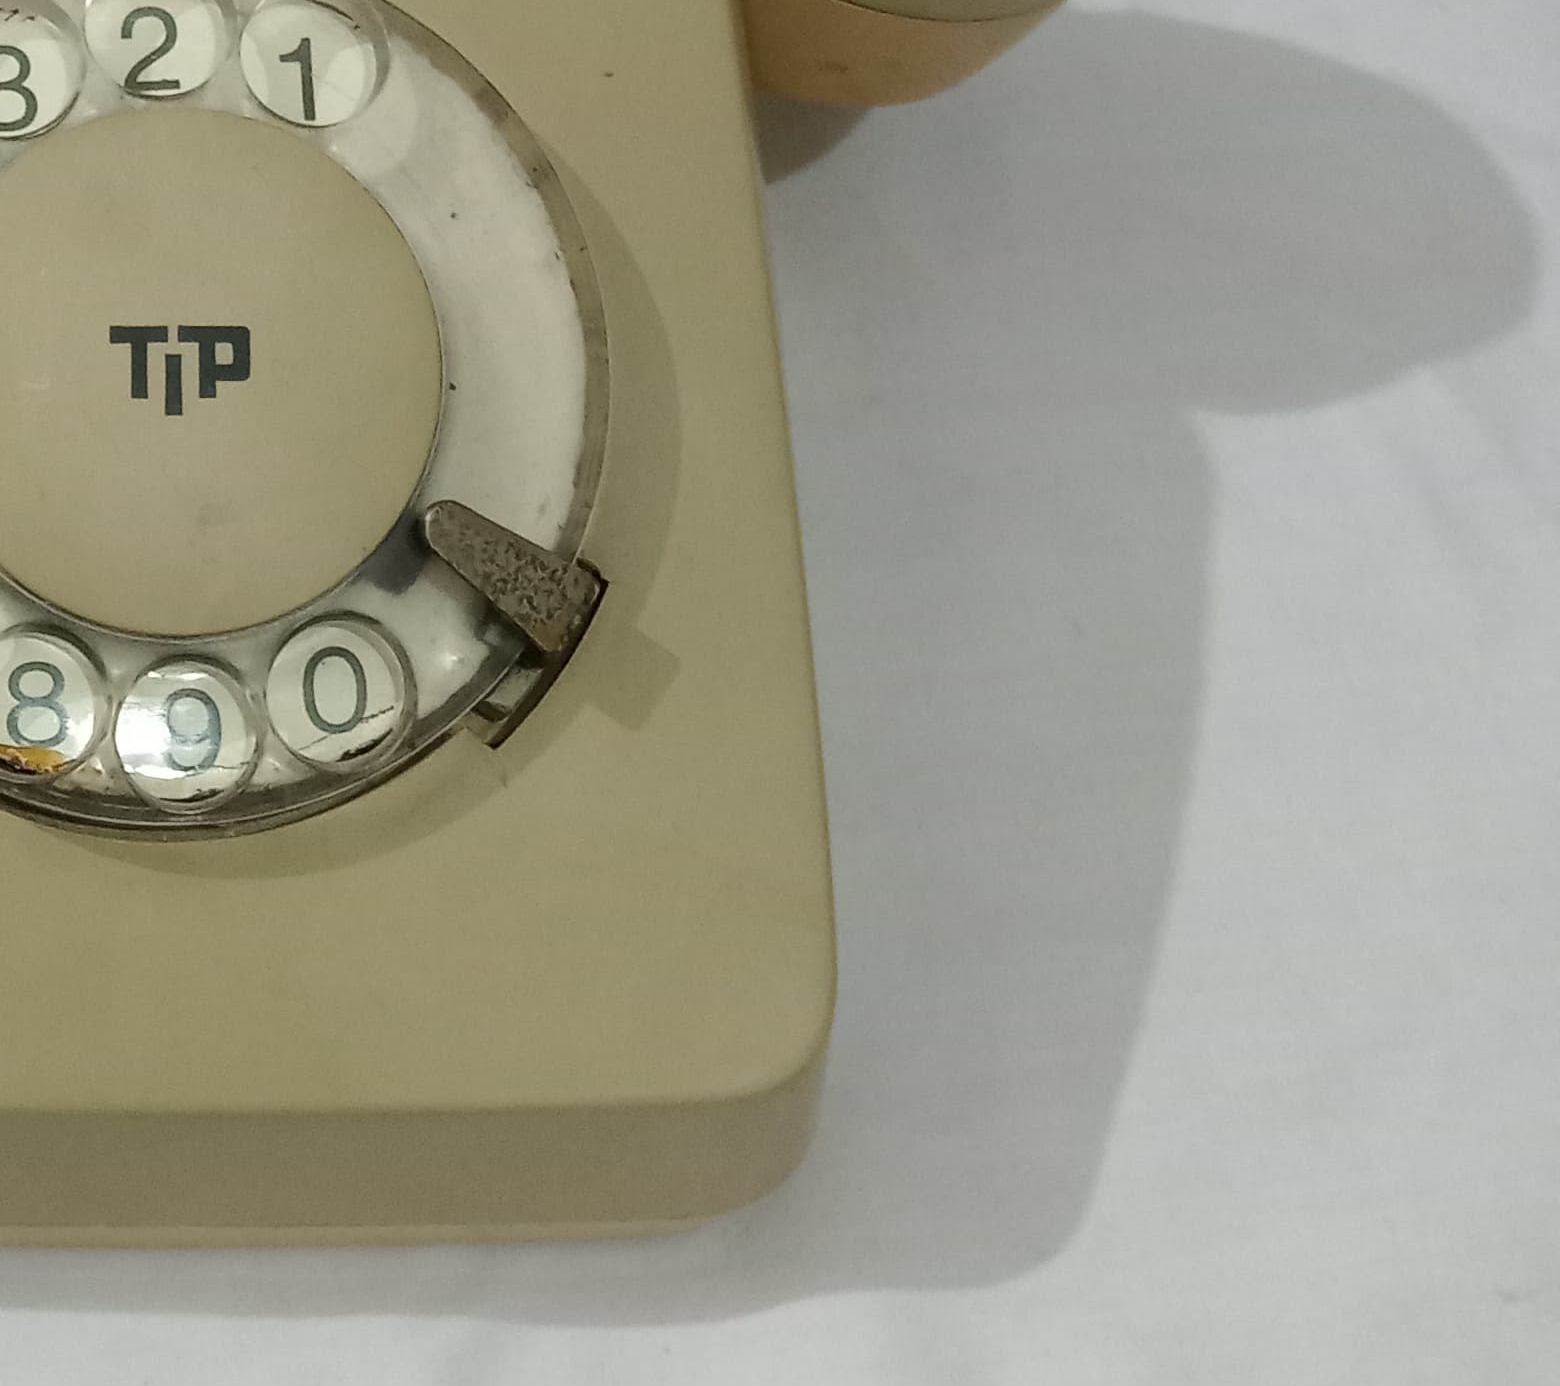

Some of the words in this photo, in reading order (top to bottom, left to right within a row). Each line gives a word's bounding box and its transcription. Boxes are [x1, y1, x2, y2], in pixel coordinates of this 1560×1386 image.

[119, 6, 181, 93] 2
[278, 37, 317, 121] 1
[5, 661, 66, 747] 8
[164, 688, 222, 771] 9
[302, 646, 365, 733] 0
